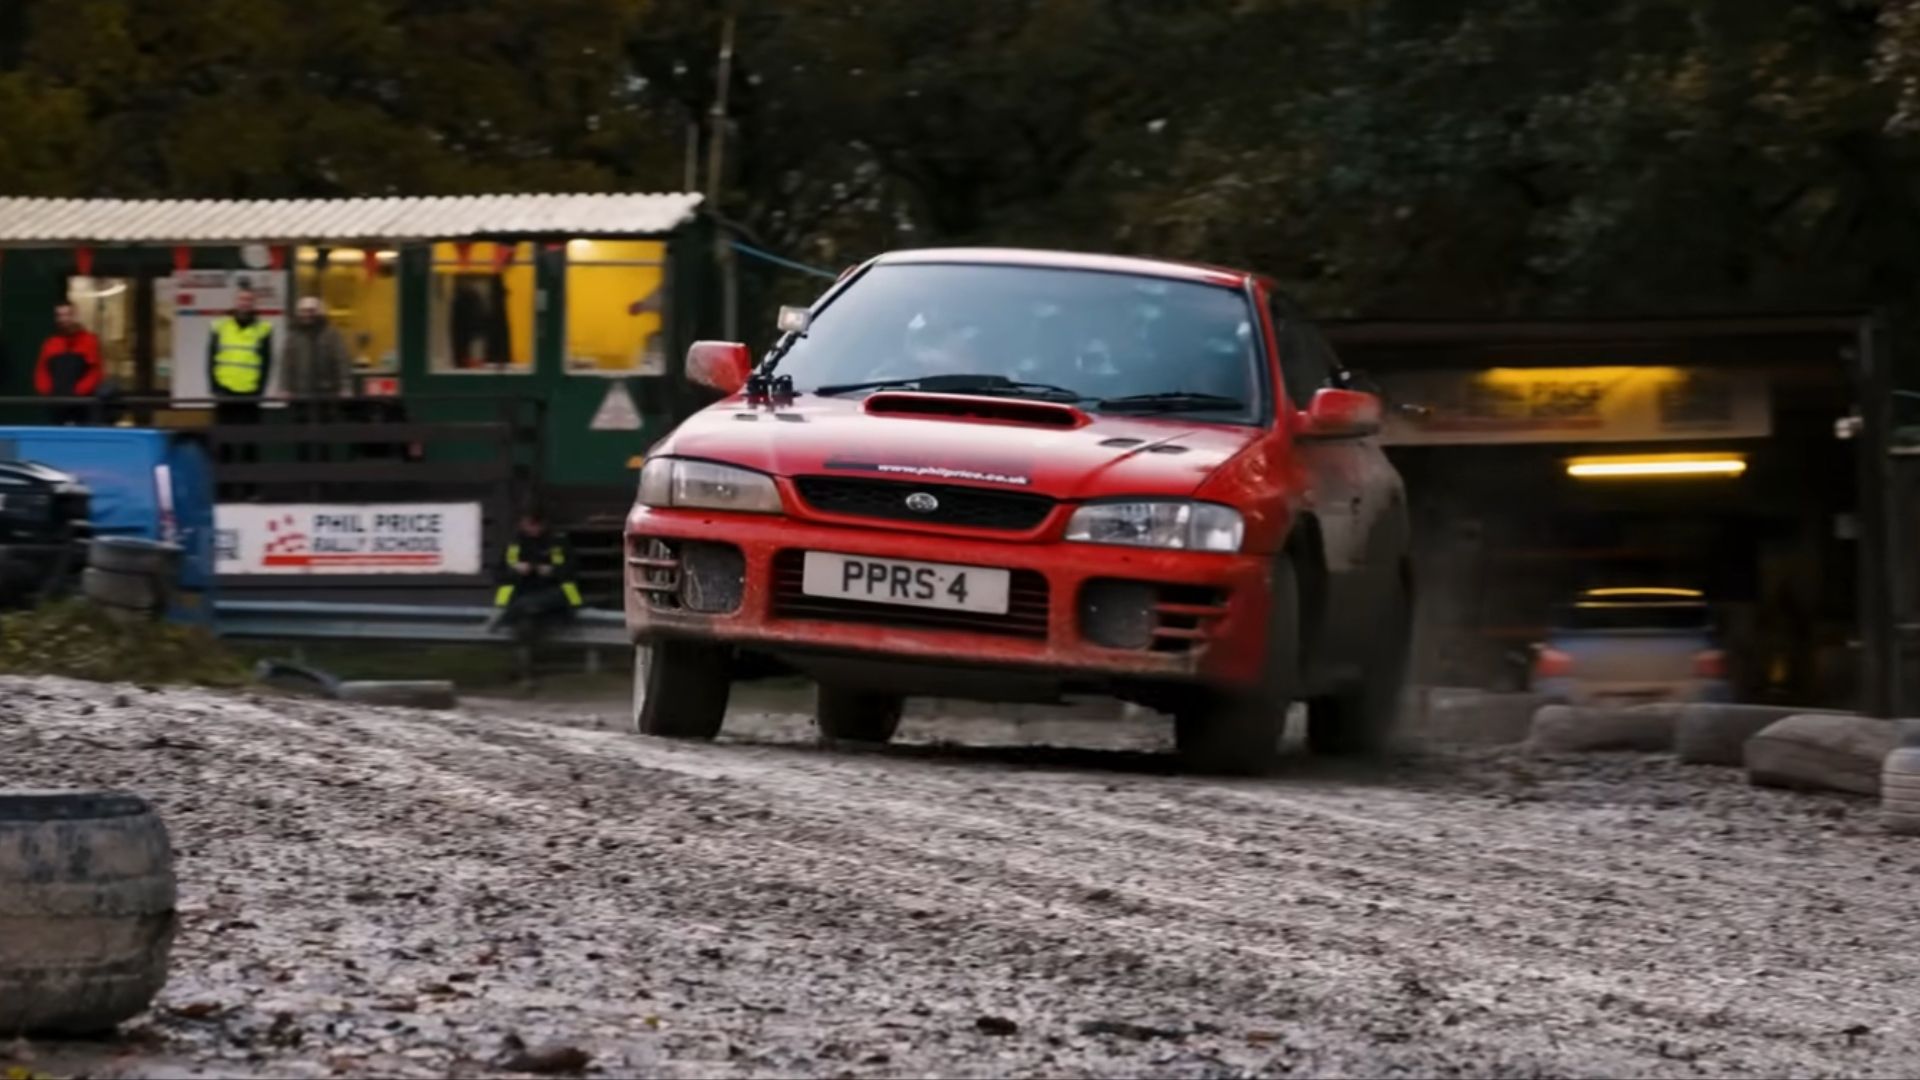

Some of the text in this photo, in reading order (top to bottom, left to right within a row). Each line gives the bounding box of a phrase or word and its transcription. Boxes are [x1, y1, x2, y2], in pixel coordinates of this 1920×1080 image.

[877, 464, 1027, 485] www.philprice.co.uk
[313, 513, 442, 533] PHIL PRICE
[842, 560, 969, 604] PPRS 4
